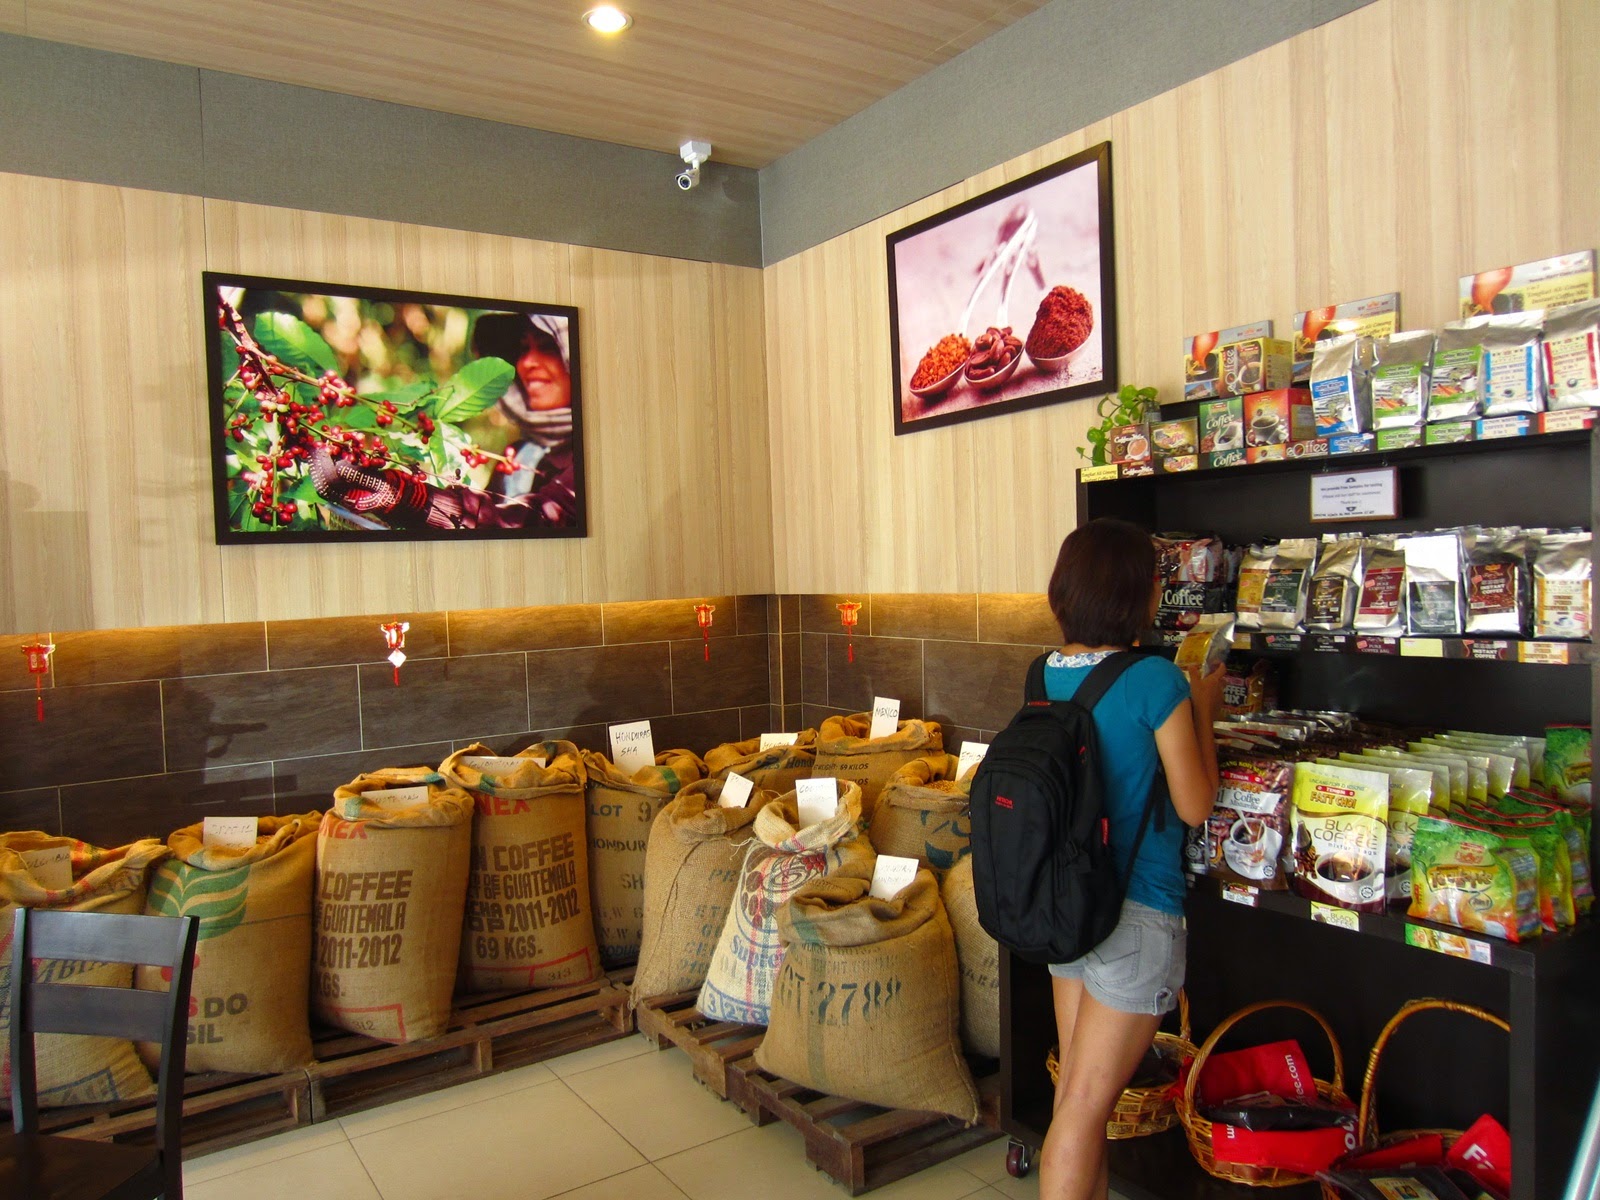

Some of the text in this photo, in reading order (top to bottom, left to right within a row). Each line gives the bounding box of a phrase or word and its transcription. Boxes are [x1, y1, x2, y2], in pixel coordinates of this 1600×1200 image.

[1206, 413, 1235, 430] Coffee
[1213, 450, 1242, 468] Coffee
[1164, 588, 1204, 606] Coffee
[874, 705, 899, 719] MEXICO
[615, 729, 651, 747] HONDURAS
[1233, 791, 1260, 804] Coffee
[591, 804, 622, 818] LOT
[493, 832, 574, 871] COFFEE
[1313, 828, 1378, 851] COFFEE
[321, 870, 414, 901] COFFEE
[503, 860, 577, 900] GUATEMALA
[322, 901, 407, 933] GUATEMALA
[505, 888, 581, 933] 2011-2012
[320, 934, 403, 969] 2011-2012
[476, 935, 543, 960] 69 KGS.
[204, 993, 249, 1018] DO
